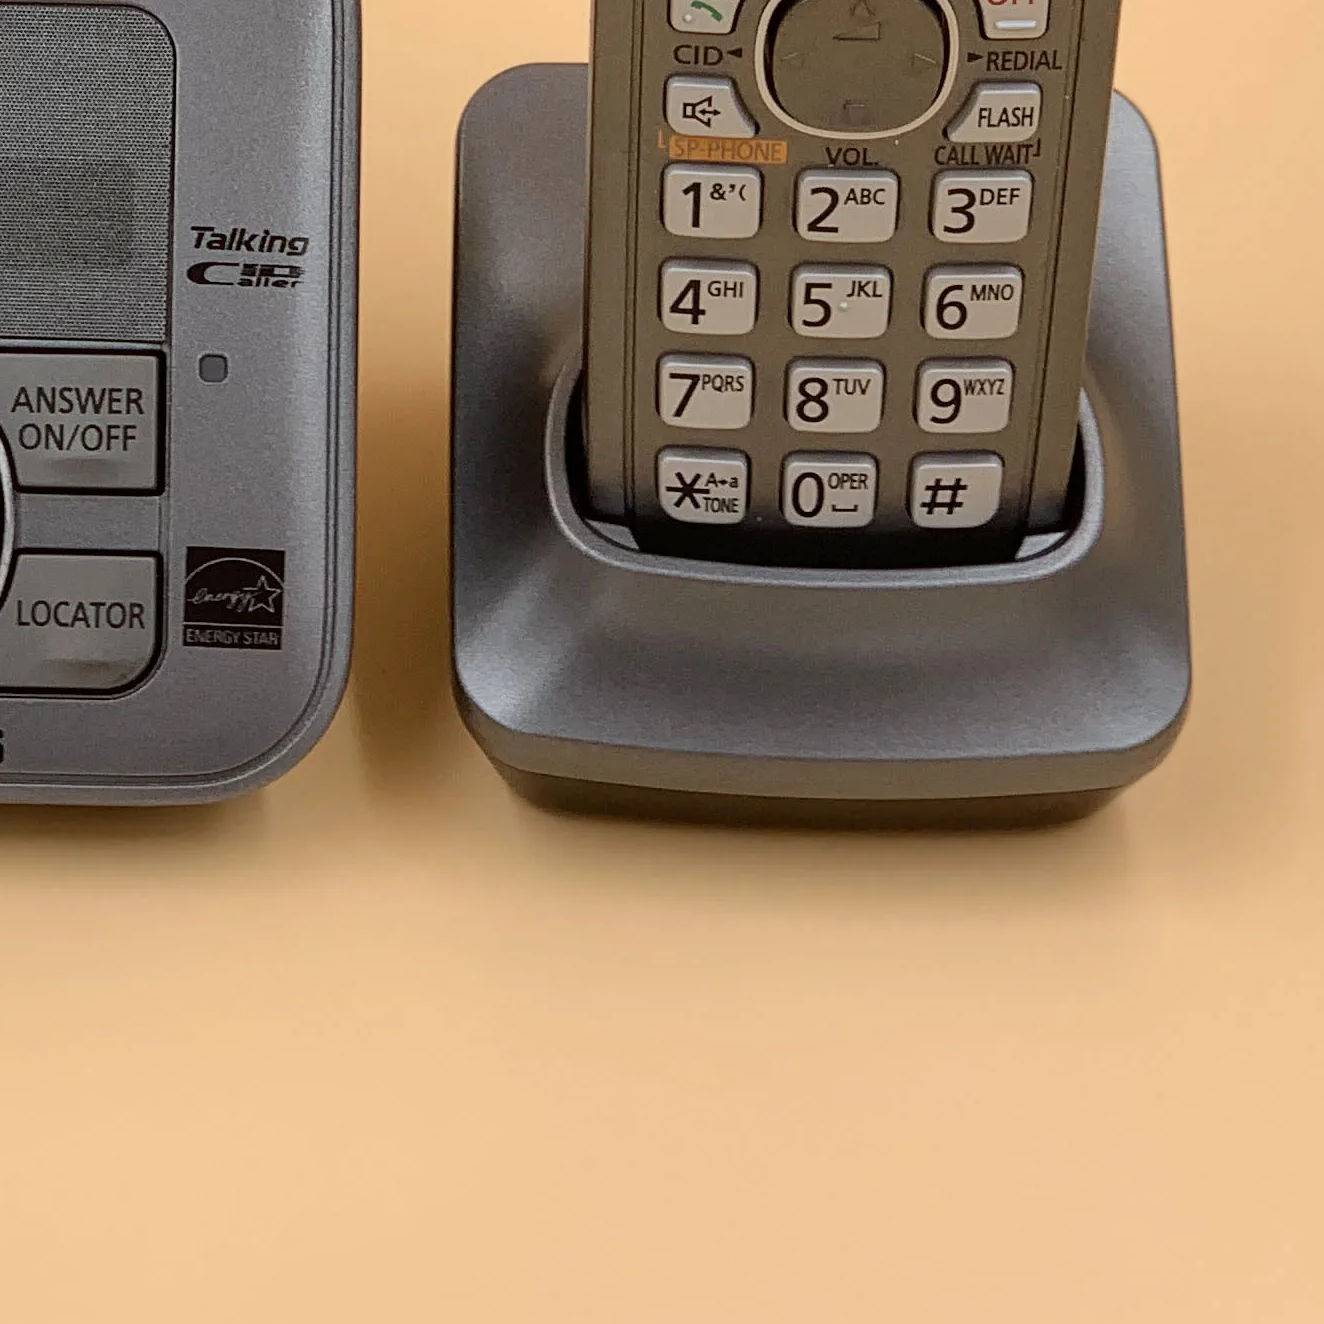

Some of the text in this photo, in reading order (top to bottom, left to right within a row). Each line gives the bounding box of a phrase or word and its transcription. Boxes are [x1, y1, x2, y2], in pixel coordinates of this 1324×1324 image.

[673, 45, 723, 67] CID
[986, 49, 1062, 72] REDIAL
[977, 106, 1034, 129] FLASH
[672, 140, 782, 163] SP-PHONE
[826, 146, 879, 167] VOL.
[934, 144, 1032, 166] CALL WAIT
[682, 181, 703, 229] 1
[806, 186, 886, 233] 2 ABC
[942, 187, 1021, 234] 3 DEF
[190, 225, 310, 256] Talking
[668, 278, 744, 325] 4 GHI
[801, 280, 883, 328] 5 JKL
[934, 284, 1014, 331] 6 MNO
[11, 386, 145, 416] ANSWER
[668, 372, 745, 418] 7 PQRS
[795, 377, 872, 423] 8 TUV
[929, 378, 1006, 424] 9 WXYZ
[17, 422, 138, 453] ON/OFF
[827, 473, 868, 491] OPER
[702, 496, 739, 513] TONE
[16, 599, 146, 630] LOCATOR
[186, 628, 279, 646] ENERGY STAR
